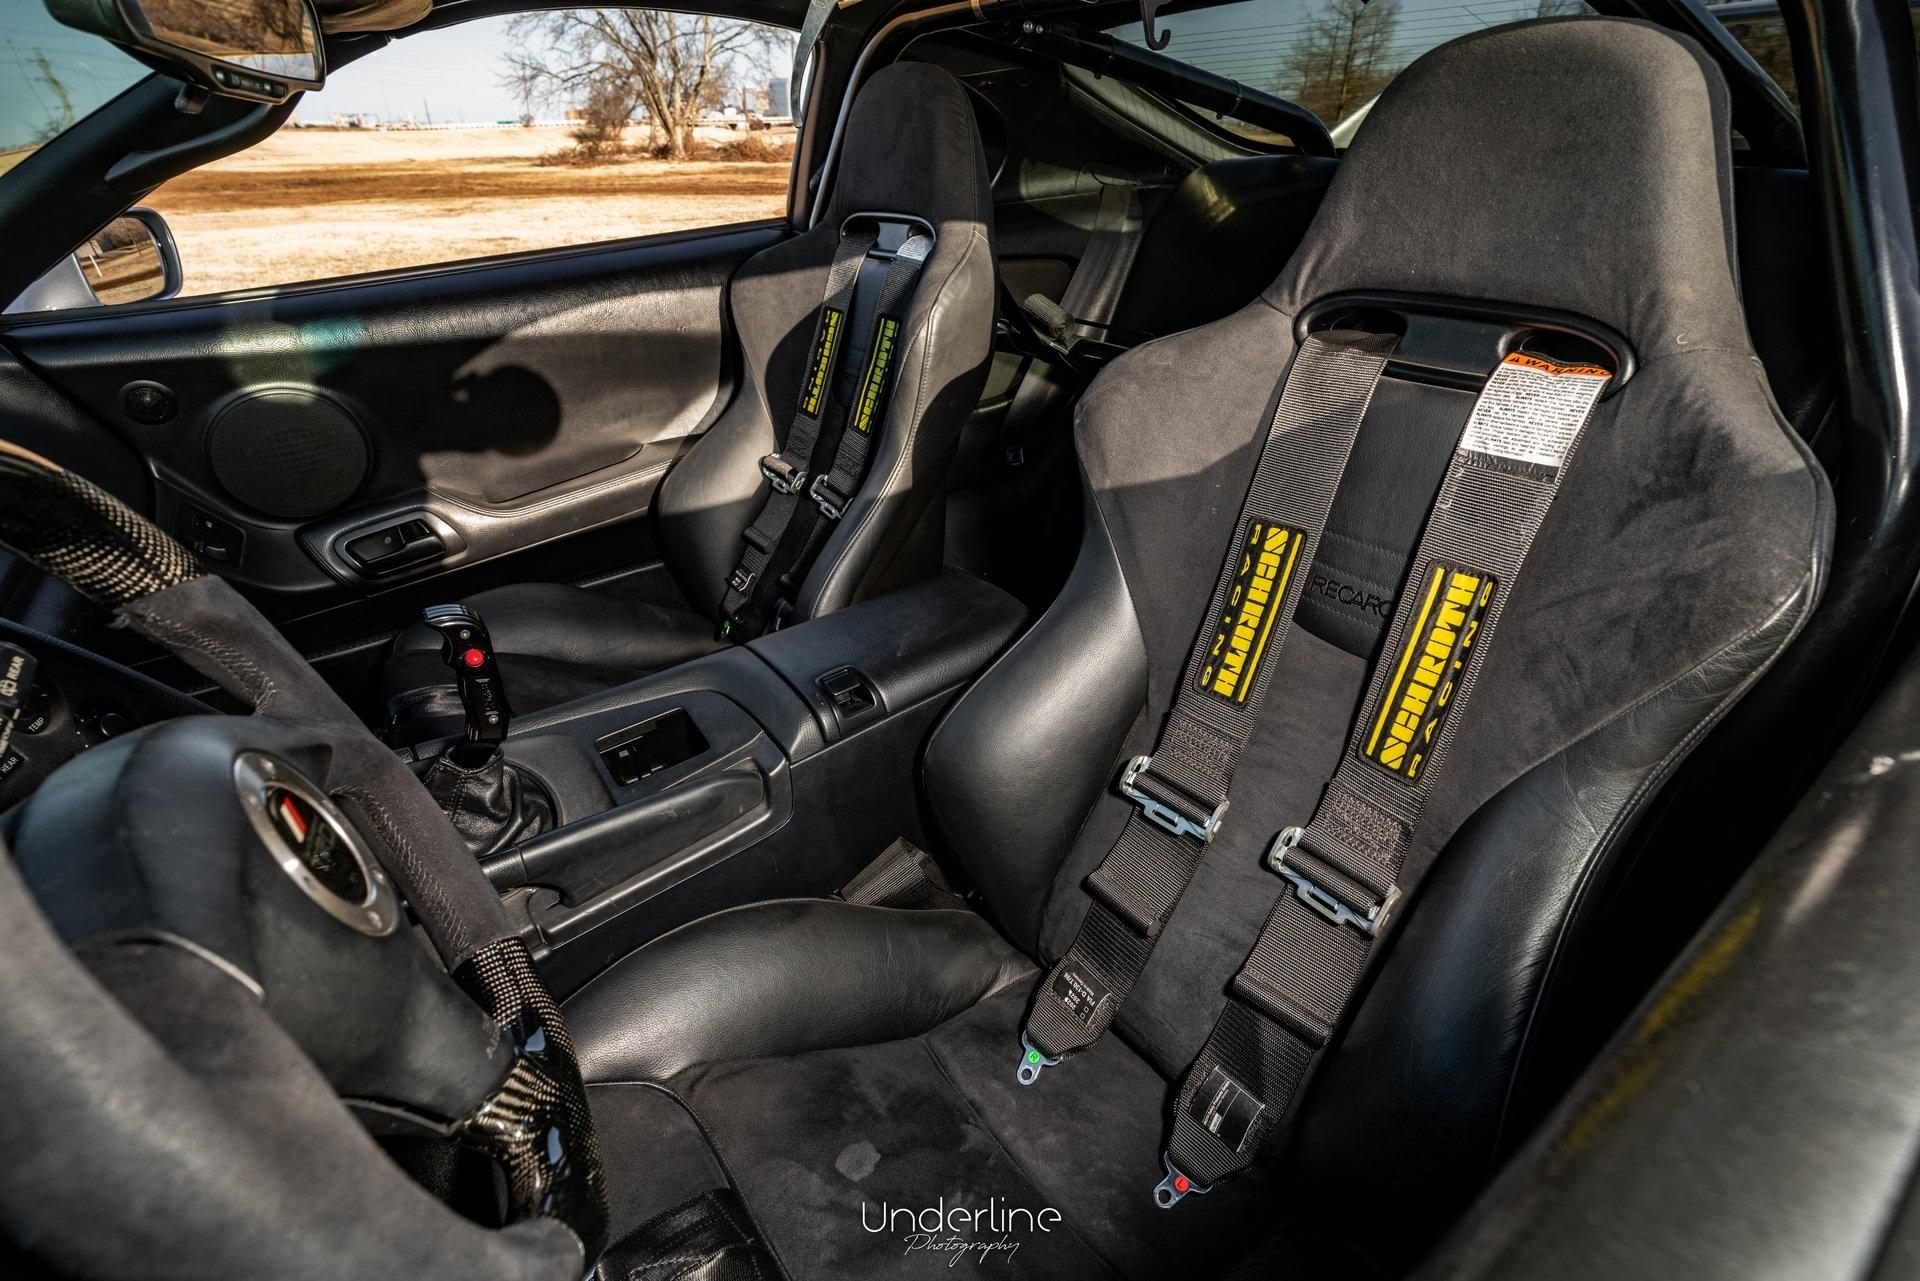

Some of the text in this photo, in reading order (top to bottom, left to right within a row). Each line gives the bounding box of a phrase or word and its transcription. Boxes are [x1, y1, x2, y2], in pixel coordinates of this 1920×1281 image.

[6, 655, 25, 680] REAR
[1201, 524, 1262, 686] RACING
[1213, 527, 1289, 698] SCHROTH
[1379, 572, 1480, 775] SCHROTH
[1407, 582, 1493, 778] RACING
[1, 756, 19, 773] REAR
[28, 716, 45, 732] TEMP
